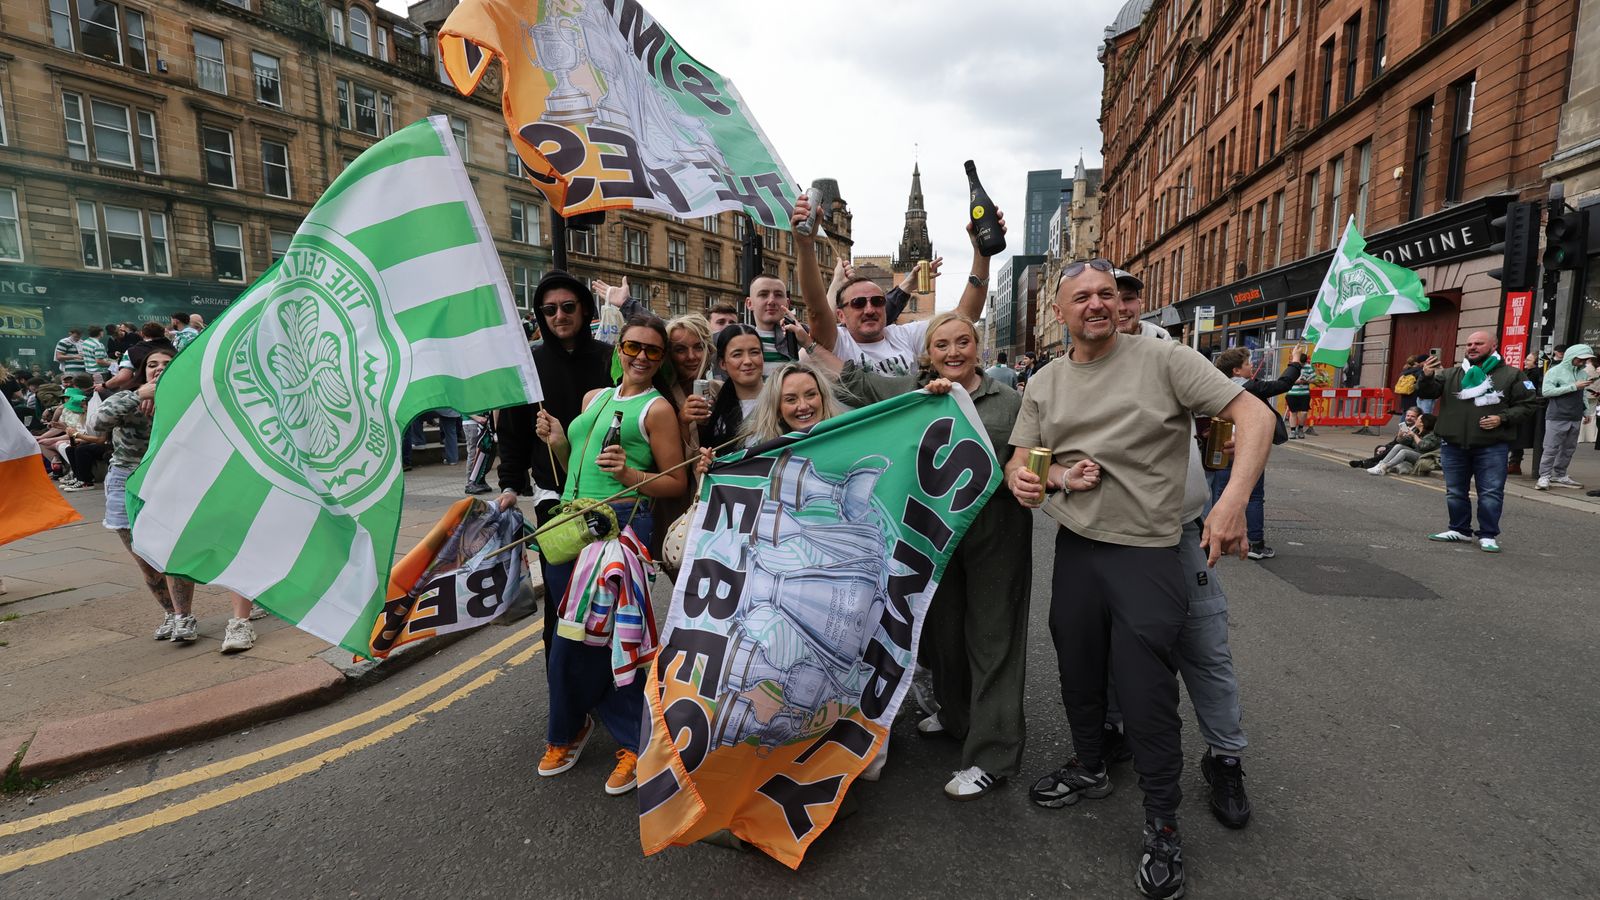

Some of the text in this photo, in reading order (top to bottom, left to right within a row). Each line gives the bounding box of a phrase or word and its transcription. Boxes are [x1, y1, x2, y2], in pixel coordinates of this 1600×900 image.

[1370, 226, 1474, 264] ONTINE
[1, 281, 34, 294] NG
[1512, 296, 1526, 308] MEET
[1513, 307, 1523, 317] YOU
[1513, 316, 1521, 326] AT
[1506, 325, 1526, 337] TONTINE
[756, 417, 994, 842] SIMPLY
